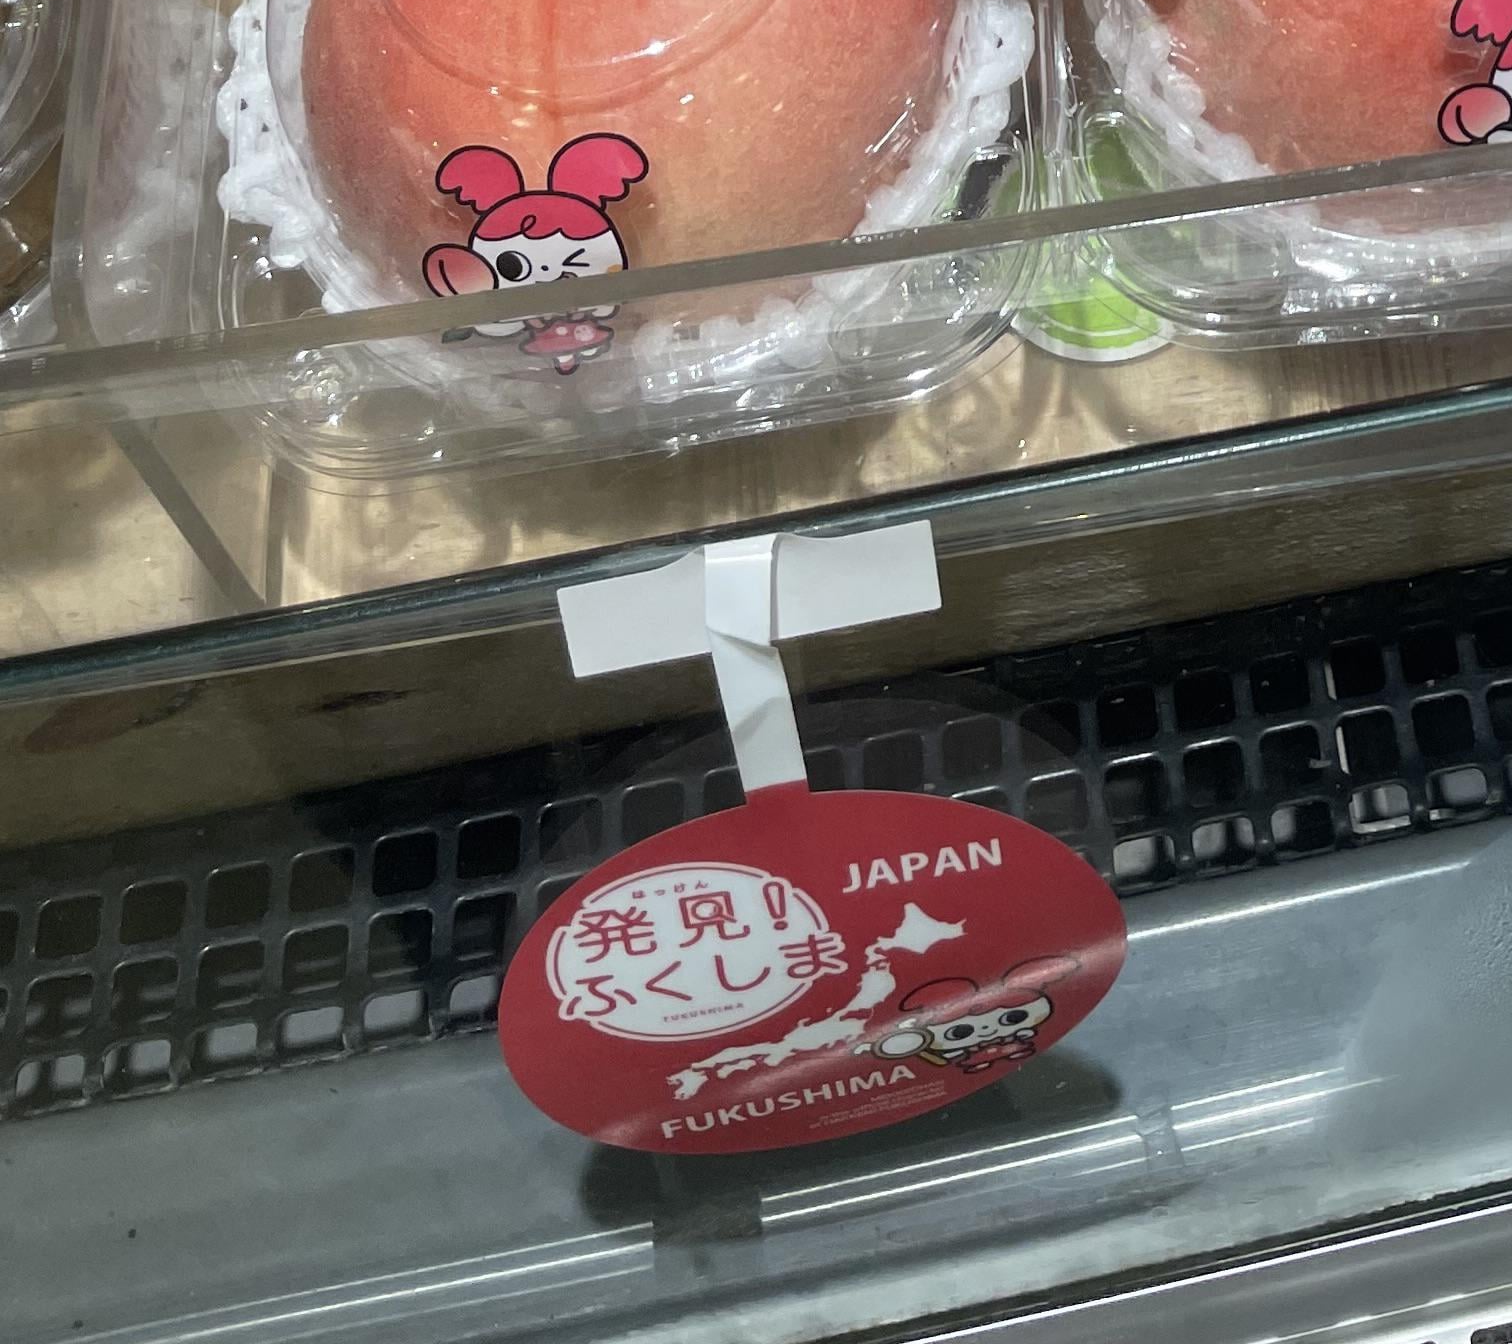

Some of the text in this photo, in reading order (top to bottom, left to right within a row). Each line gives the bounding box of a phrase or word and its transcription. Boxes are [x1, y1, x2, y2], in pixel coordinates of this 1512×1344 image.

[841, 837, 1004, 894] JAPAN
[566, 933, 847, 1017] ふくしま
[661, 1064, 917, 1140] FUKUSHIMA
